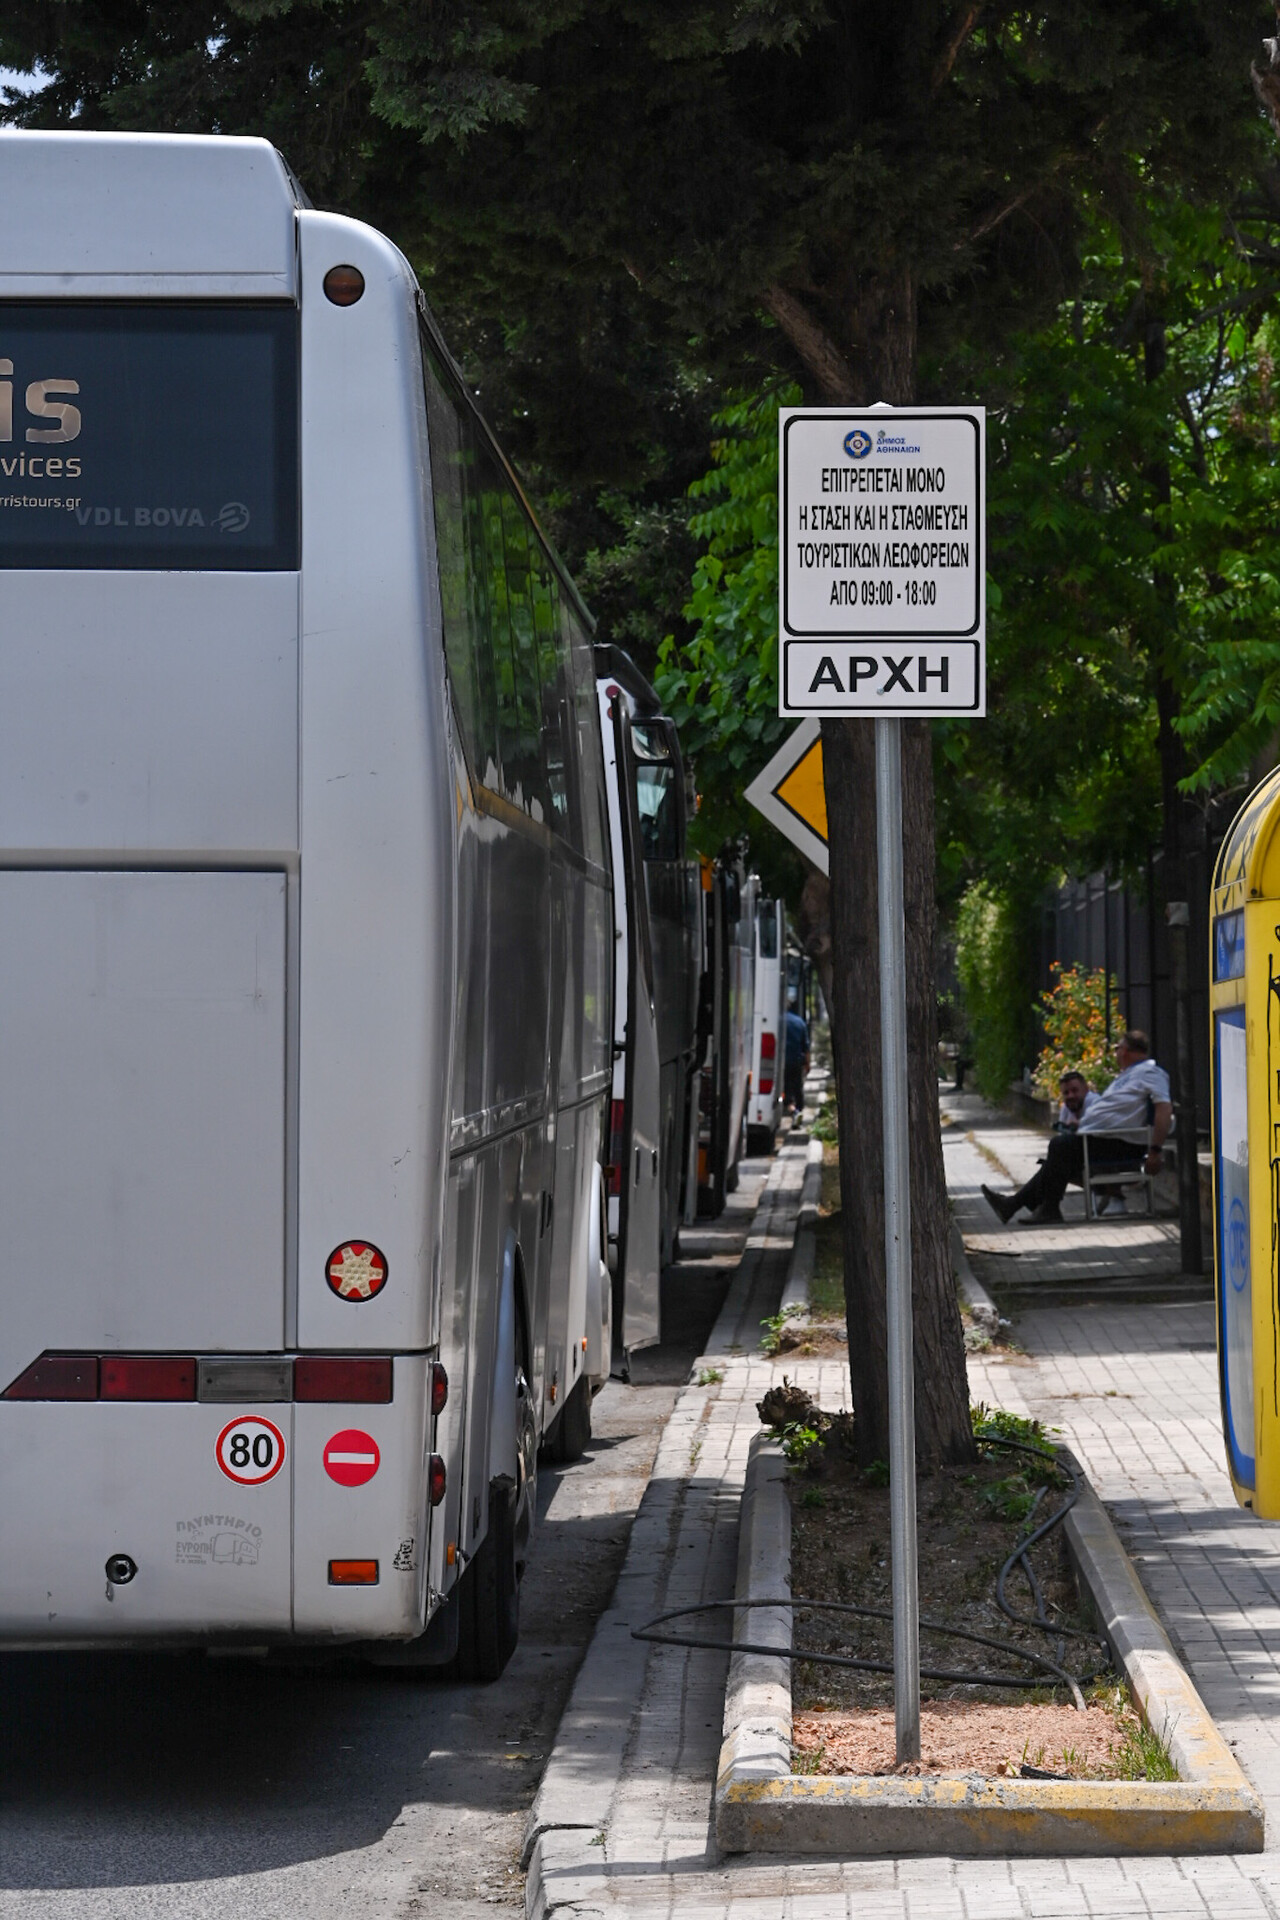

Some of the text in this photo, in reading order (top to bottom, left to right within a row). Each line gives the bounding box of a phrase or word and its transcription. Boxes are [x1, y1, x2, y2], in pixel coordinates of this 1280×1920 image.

[876, 437, 906, 445] ΔΗΜΟΣ
[876, 446, 921, 454] ΑΘΗΝΑΙΩΝ
[0, 451, 82, 478] vices
[821, 467, 945, 493] ΕΠΙΤΡΕΠΕΤΑΙ ΜΟΝΟ
[74, 507, 205, 528] VDL BOVA
[799, 504, 968, 530] Η ΣΤΑΣΗ ΚΑΙ Η ΣΤΑΘΜΕΥΣΗ
[797, 542, 969, 568] ΤΟΥΡΙΣΤΙΚΩΝ ΛΕΩΦΟΡΕΙΩΝ
[829, 580, 858, 606] ΑΠΟ
[861, 580, 893, 606] 09:00
[904, 580, 936, 606] 18:00
[807, 656, 949, 693] ΑΡΧΗ
[229, 1433, 274, 1468] 80
[175, 1514, 263, 1538] ΠΛΥΝΤΗΡΙΟ
